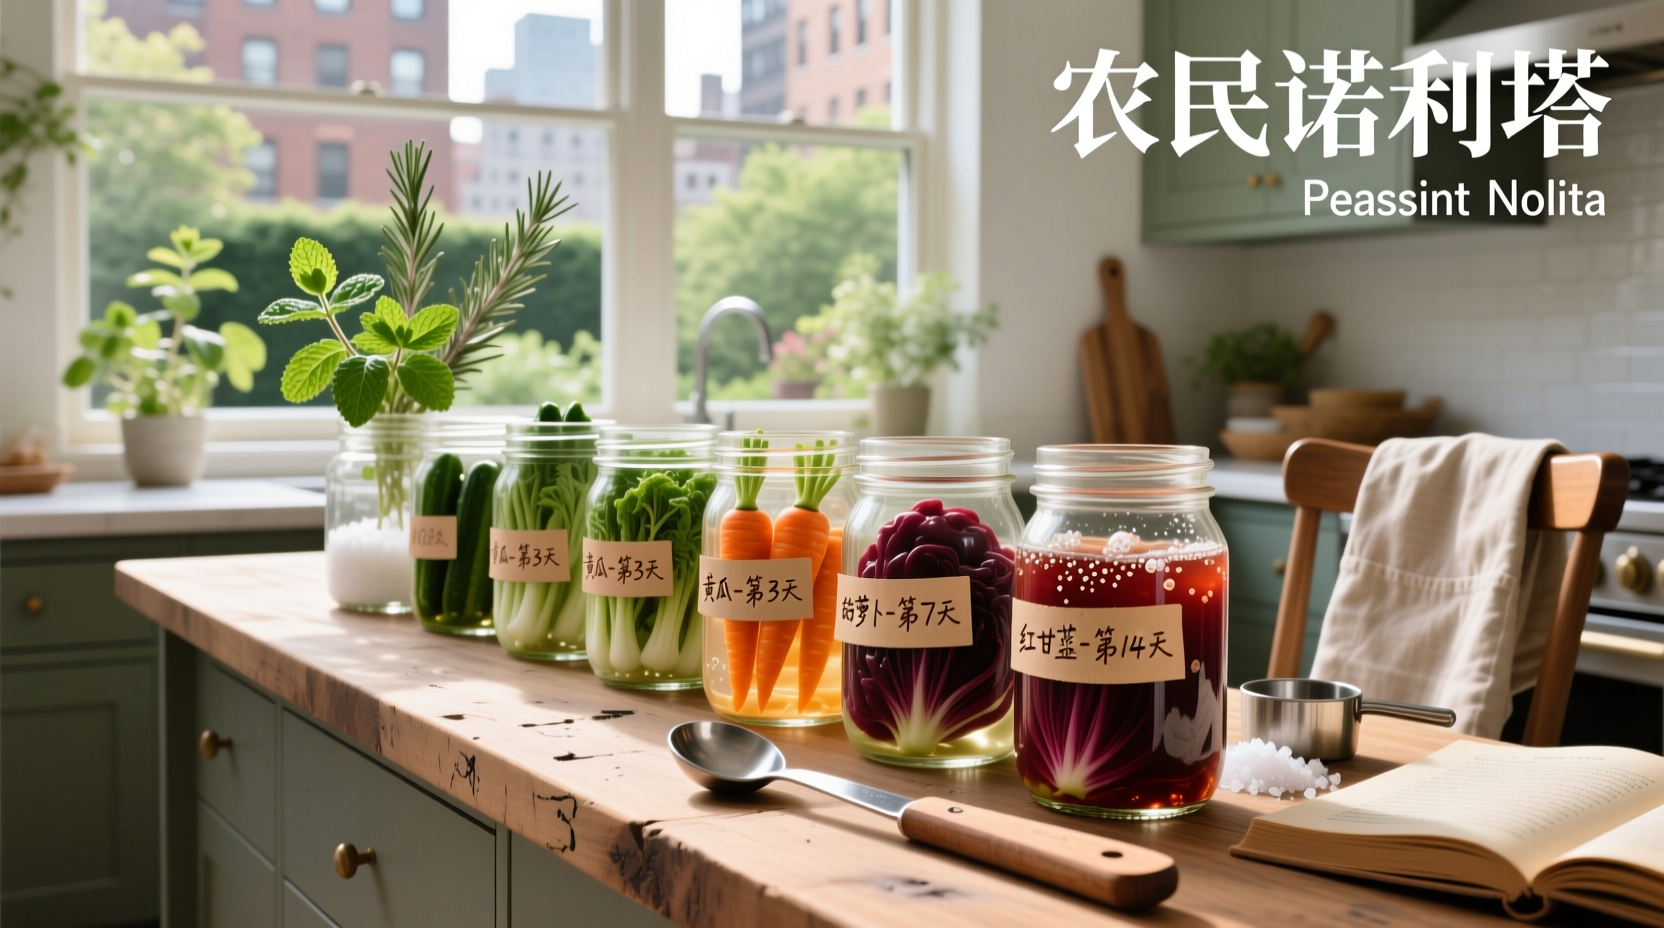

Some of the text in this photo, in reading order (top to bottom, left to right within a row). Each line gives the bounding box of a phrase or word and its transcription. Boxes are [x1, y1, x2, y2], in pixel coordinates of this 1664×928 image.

[583, 551, 665, 585] 黄瓜-第3天
[702, 572, 803, 608] 黄瓜-第3天
